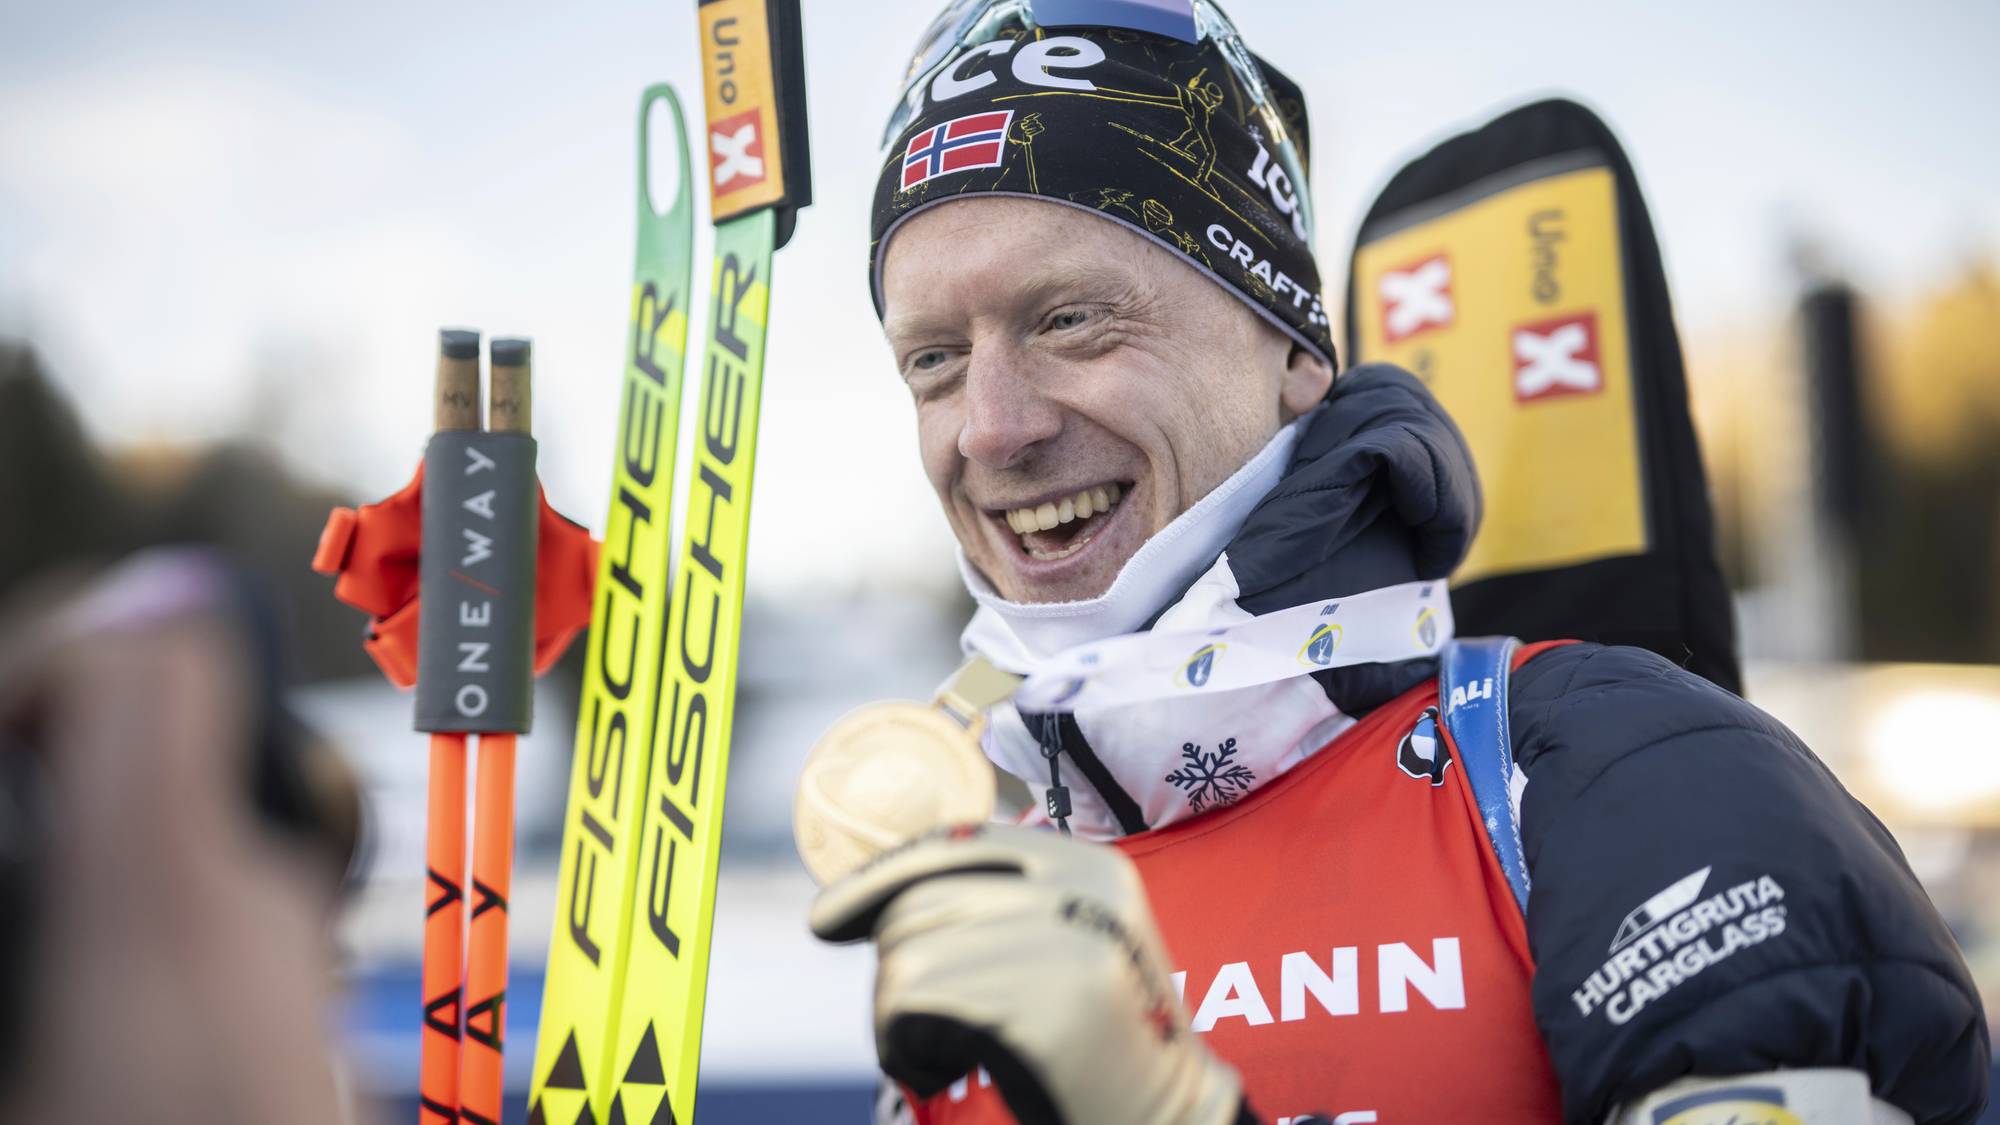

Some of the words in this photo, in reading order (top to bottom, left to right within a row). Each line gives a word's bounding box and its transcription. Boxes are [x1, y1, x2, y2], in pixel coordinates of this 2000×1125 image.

[713, 18, 741, 105] Uno
[1206, 224, 1311, 309] CRAFT
[1526, 208, 1570, 306] Uno
[569, 279, 678, 968] FISCHER
[647, 252, 758, 961] FISCHER
[1571, 874, 1786, 1017] HURTIGRUTA
